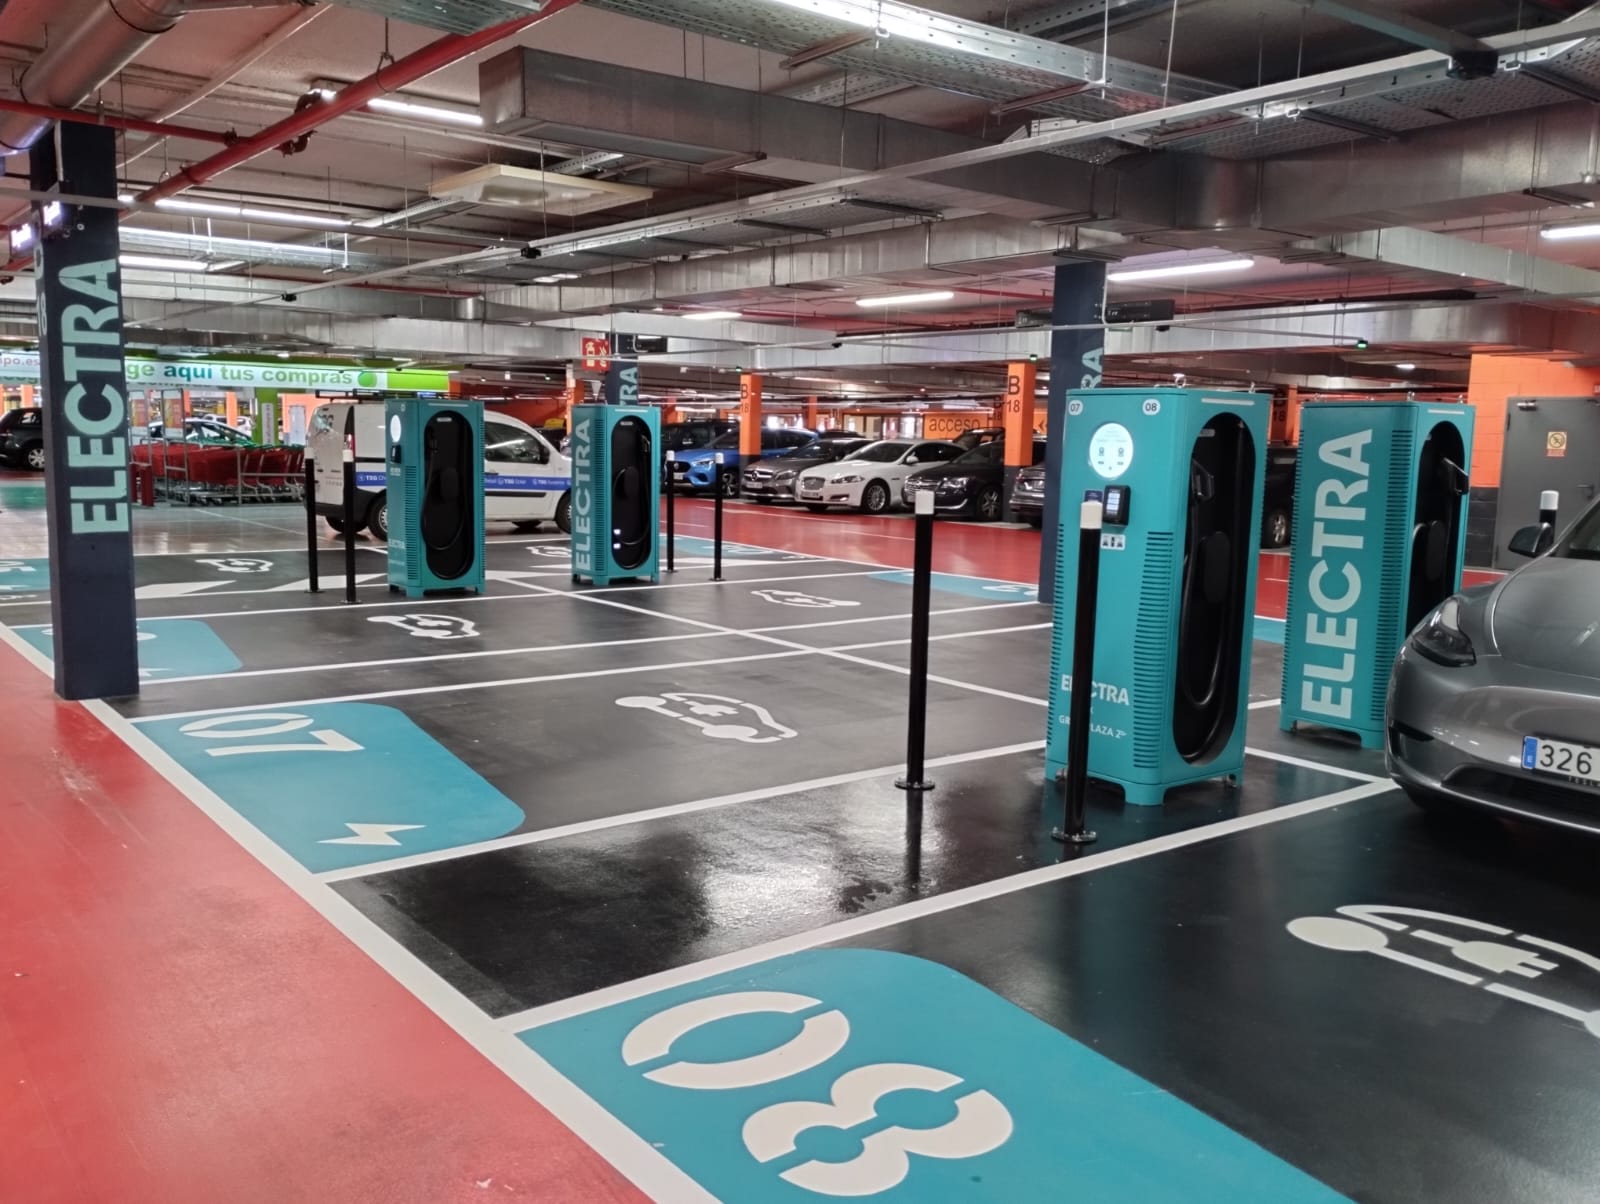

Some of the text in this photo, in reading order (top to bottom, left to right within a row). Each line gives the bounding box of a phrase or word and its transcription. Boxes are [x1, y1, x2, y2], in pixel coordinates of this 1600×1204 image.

[220, 365, 254, 381] tus
[261, 369, 352, 386] compras
[1008, 375, 1020, 395] B
[58, 258, 130, 534] ELECTRA
[1006, 400, 1020, 413] 18
[1069, 403, 1081, 413] 07
[1145, 402, 1157, 412] 08
[928, 416, 981, 432] acceso
[574, 418, 592, 571] ELECTRA
[1300, 428, 1373, 720] ELECTRA
[178, 712, 365, 757] 07
[1540, 744, 1593, 775] 326
[621, 990, 1014, 1197] 08
